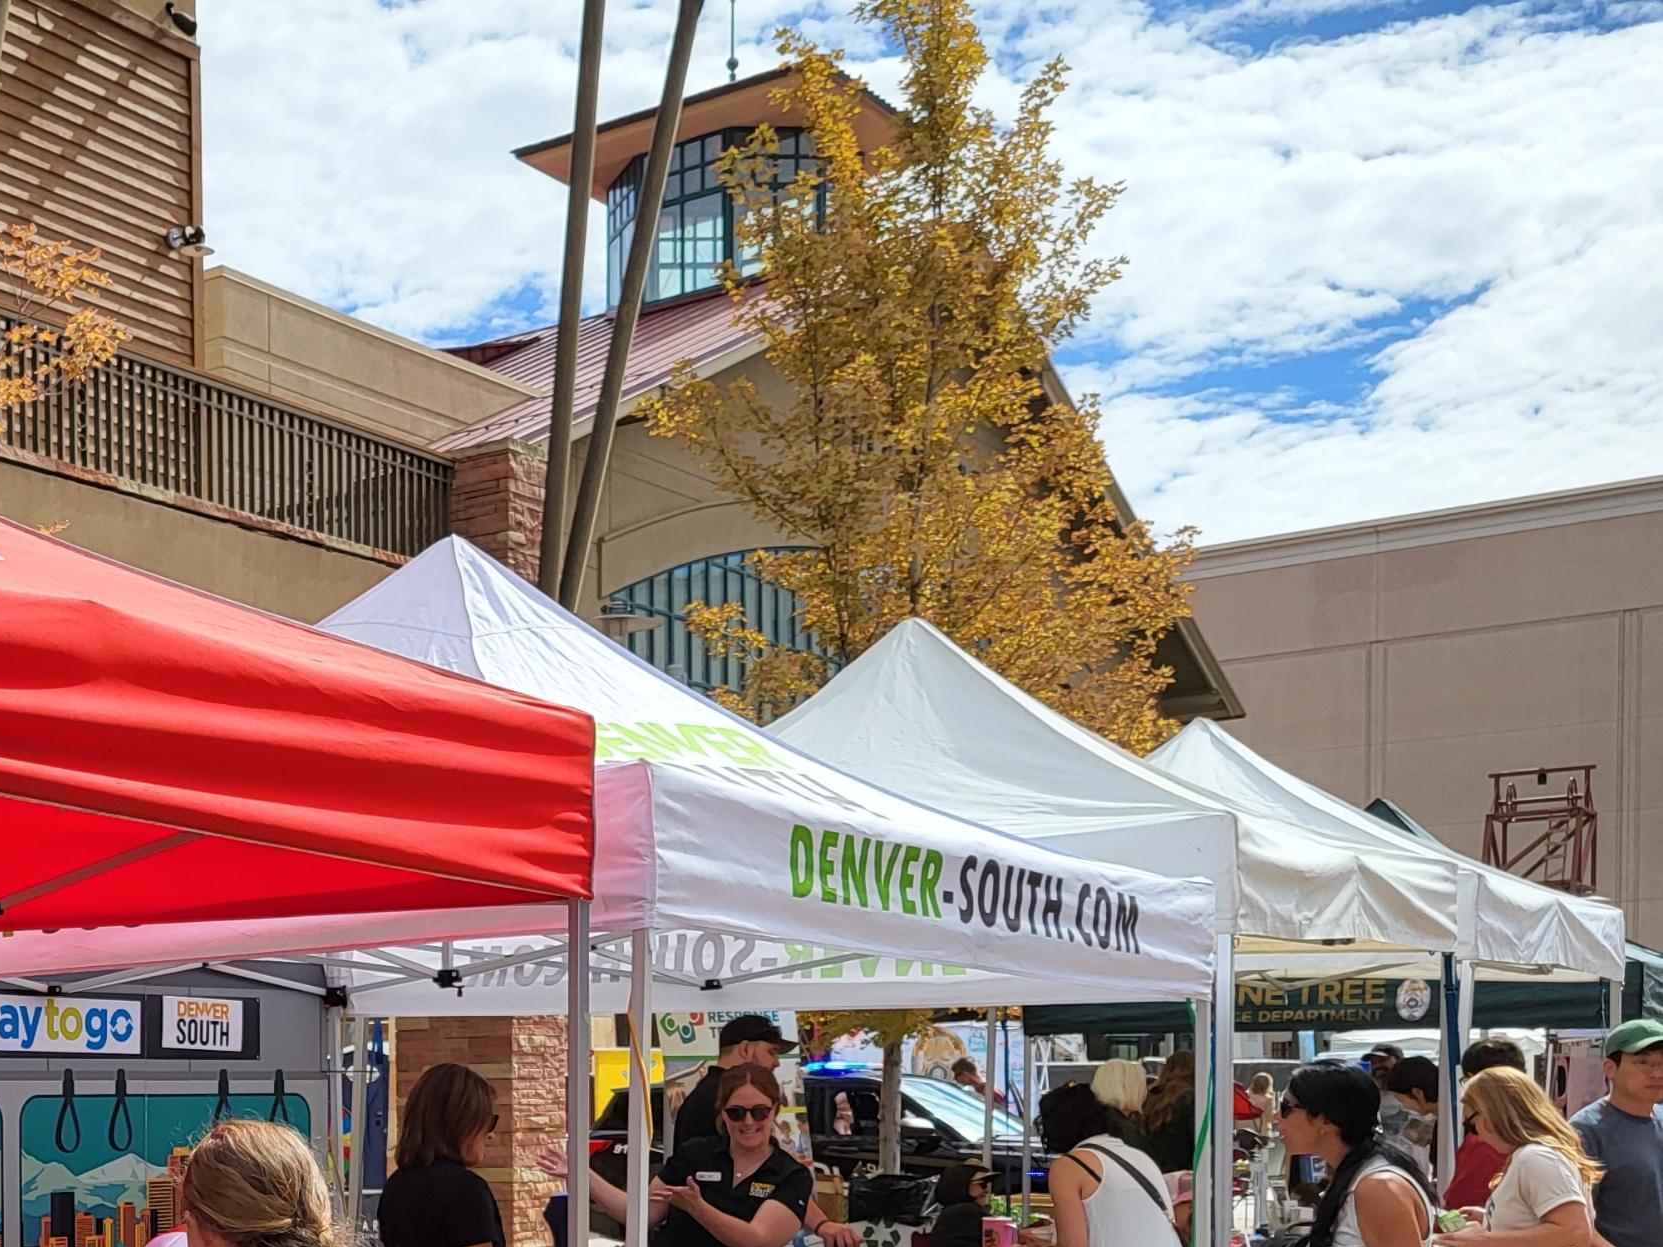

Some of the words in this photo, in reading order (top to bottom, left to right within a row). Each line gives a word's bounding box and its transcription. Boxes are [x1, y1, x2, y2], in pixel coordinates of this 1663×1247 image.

[595, 721, 793, 770] ENVER
[789, 823, 1141, 955] DENVER-SOUTH.COM
[1292, 979, 1387, 1006] TREE
[176, 1000, 230, 1019] DENVER
[1258, 1008, 1383, 1024] DEPARTMENT
[176, 1018, 230, 1047] SOUTH
